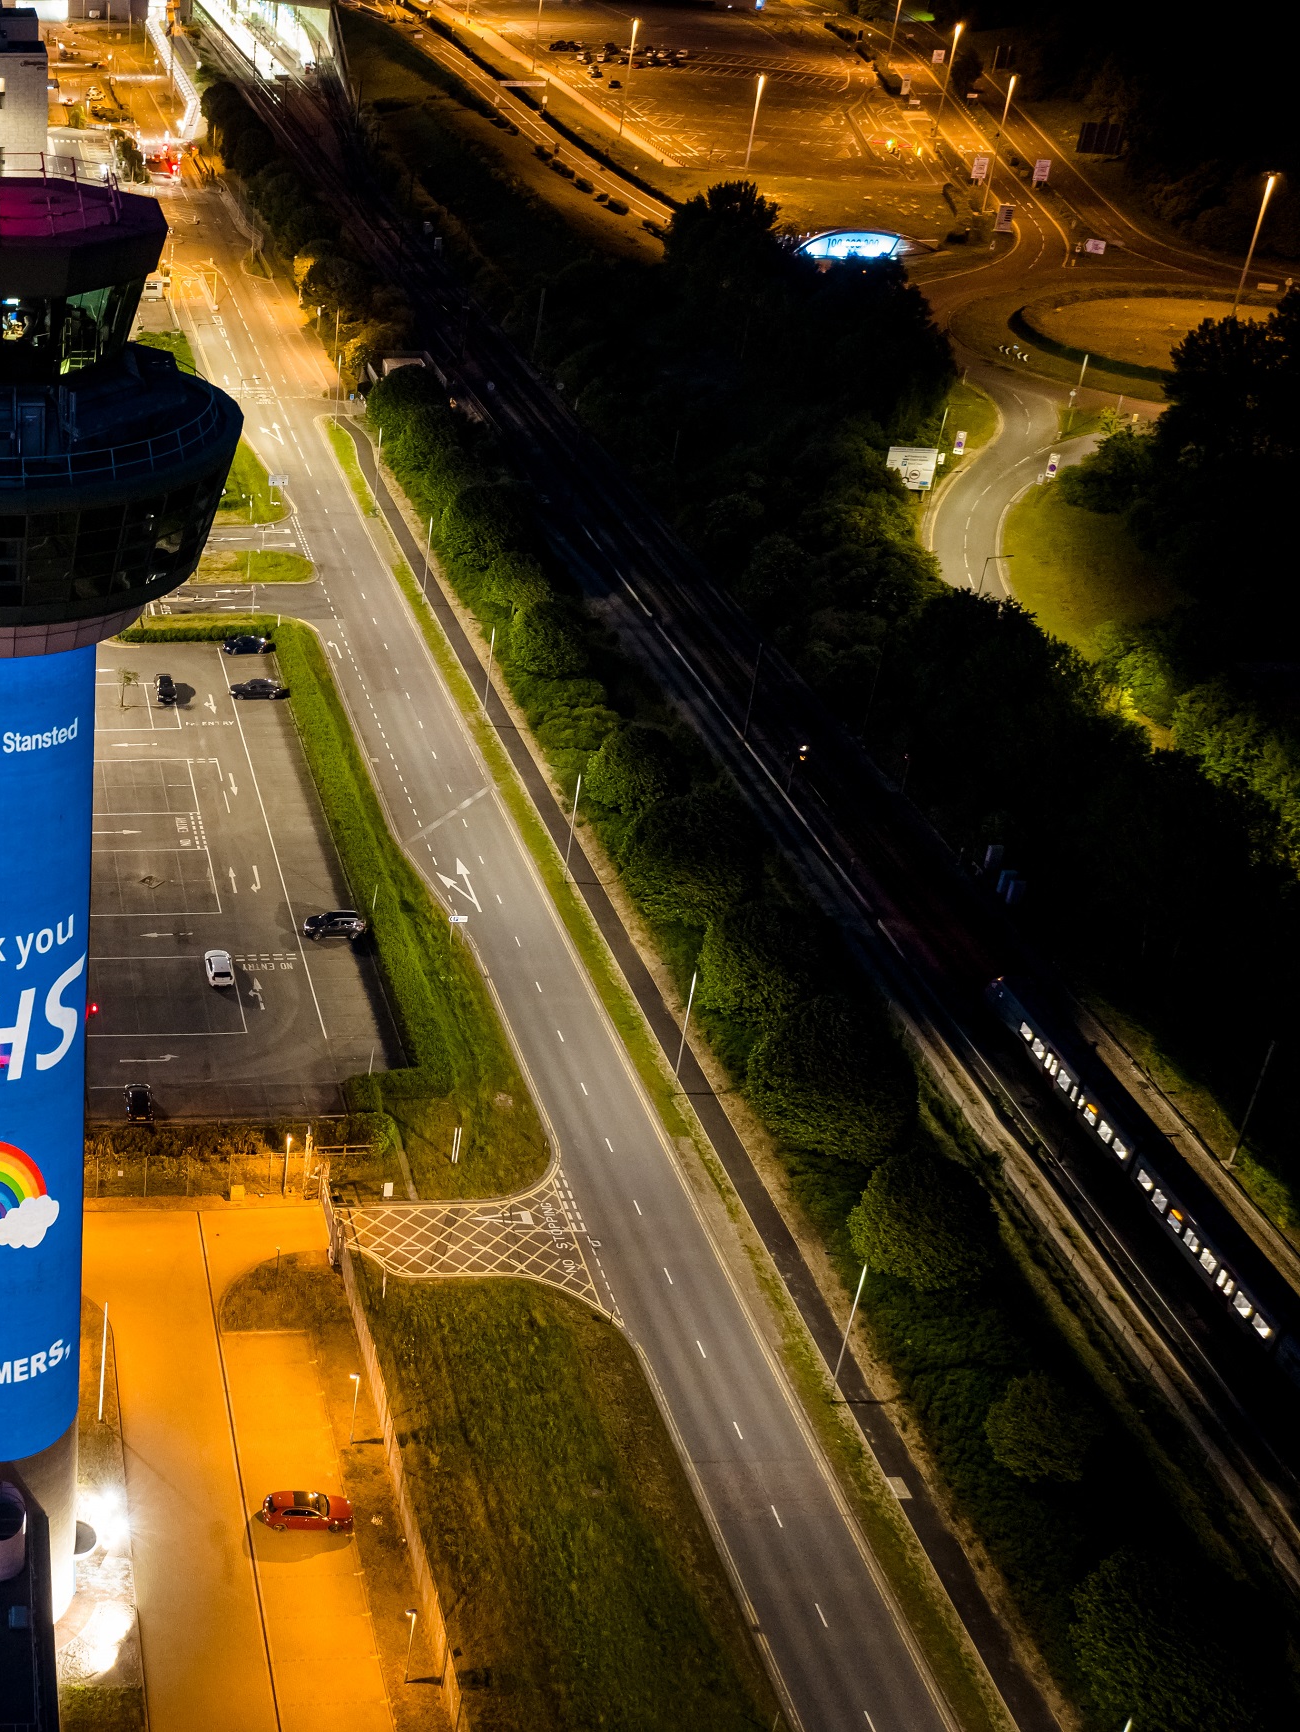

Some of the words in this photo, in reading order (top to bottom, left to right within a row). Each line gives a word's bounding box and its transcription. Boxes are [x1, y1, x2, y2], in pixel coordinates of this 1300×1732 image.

[3, 716, 79, 754] Stansted
[15, 913, 74, 970] you
[242, 962, 275, 971] ENTRY
[280, 962, 294, 970] NO
[541, 1202, 569, 1250] STOPPING
[562, 1259, 578, 1274] NO
